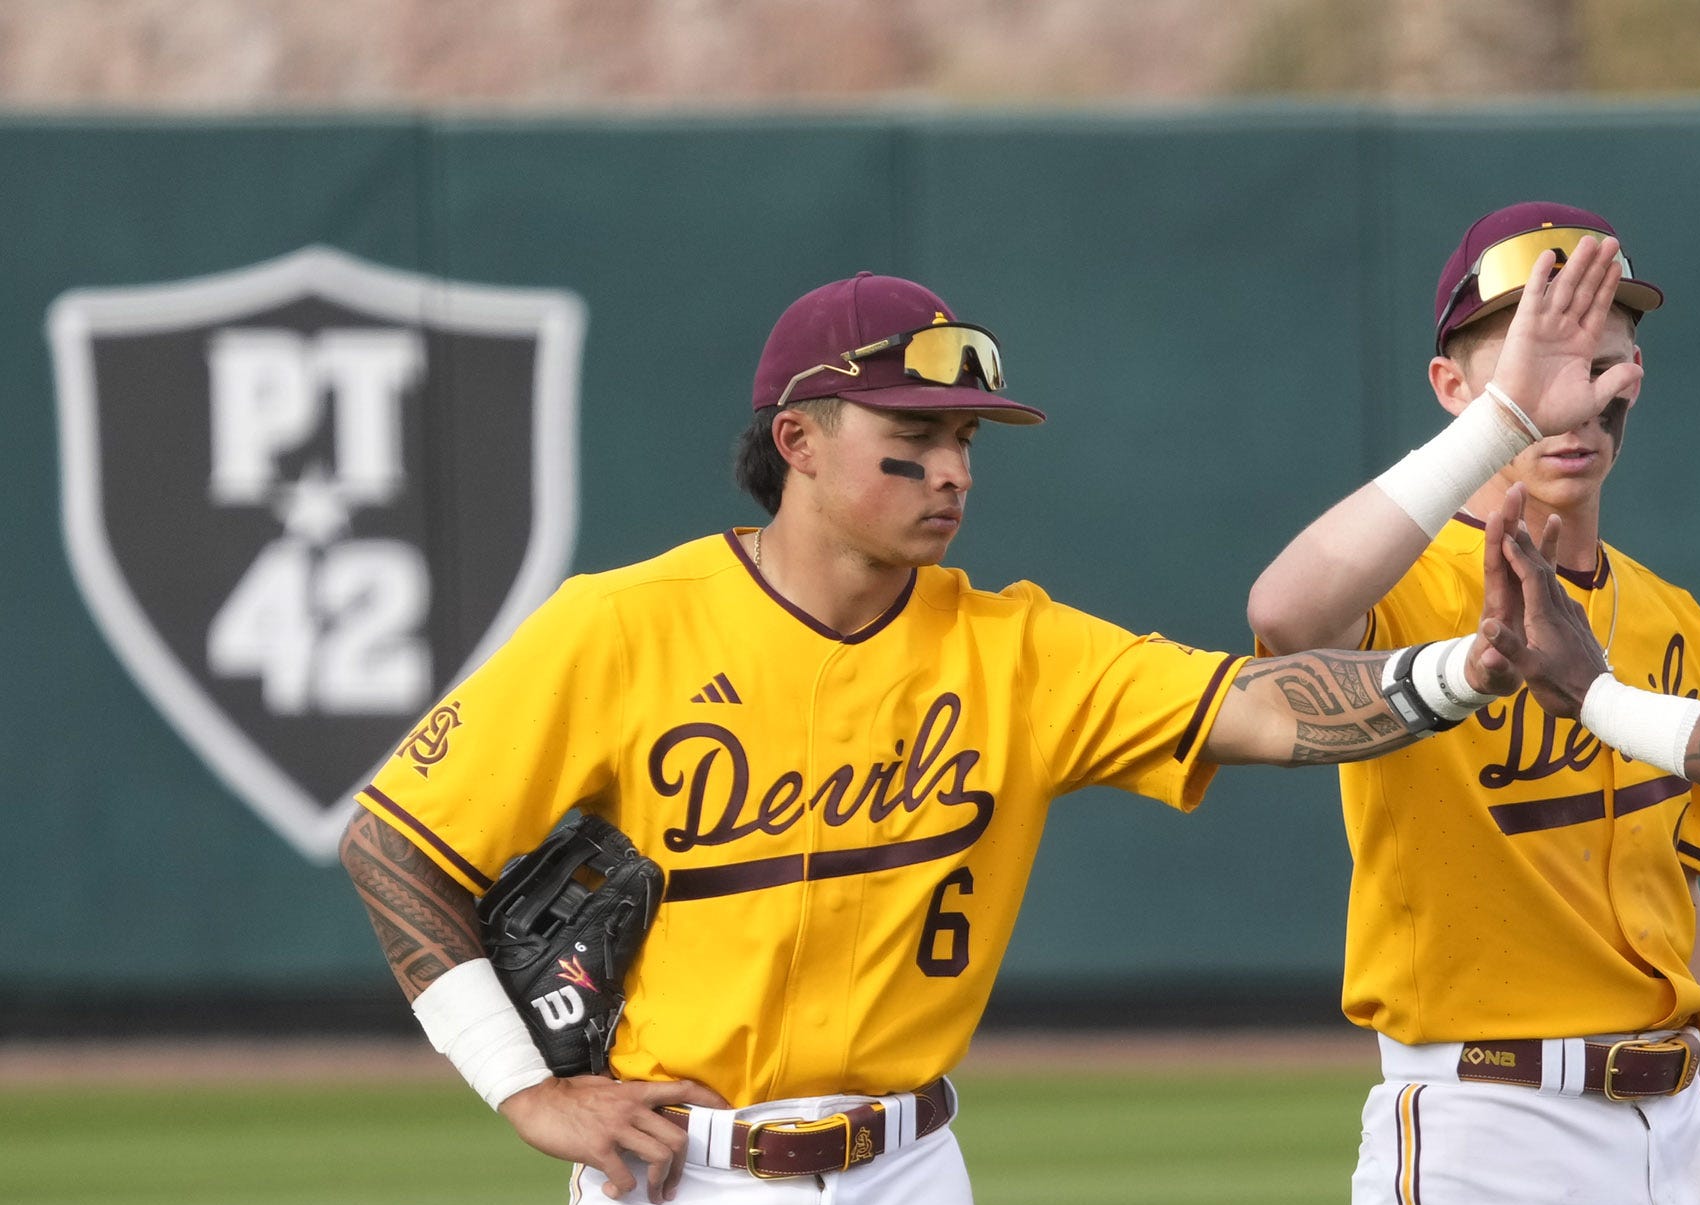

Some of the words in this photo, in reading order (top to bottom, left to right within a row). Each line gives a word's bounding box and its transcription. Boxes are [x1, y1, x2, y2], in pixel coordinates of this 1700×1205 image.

[208, 326, 426, 502] PT
[205, 534, 435, 716] 42
[648, 692, 995, 853] Devils
[916, 867, 974, 978] 6
[531, 985, 585, 1030] W
